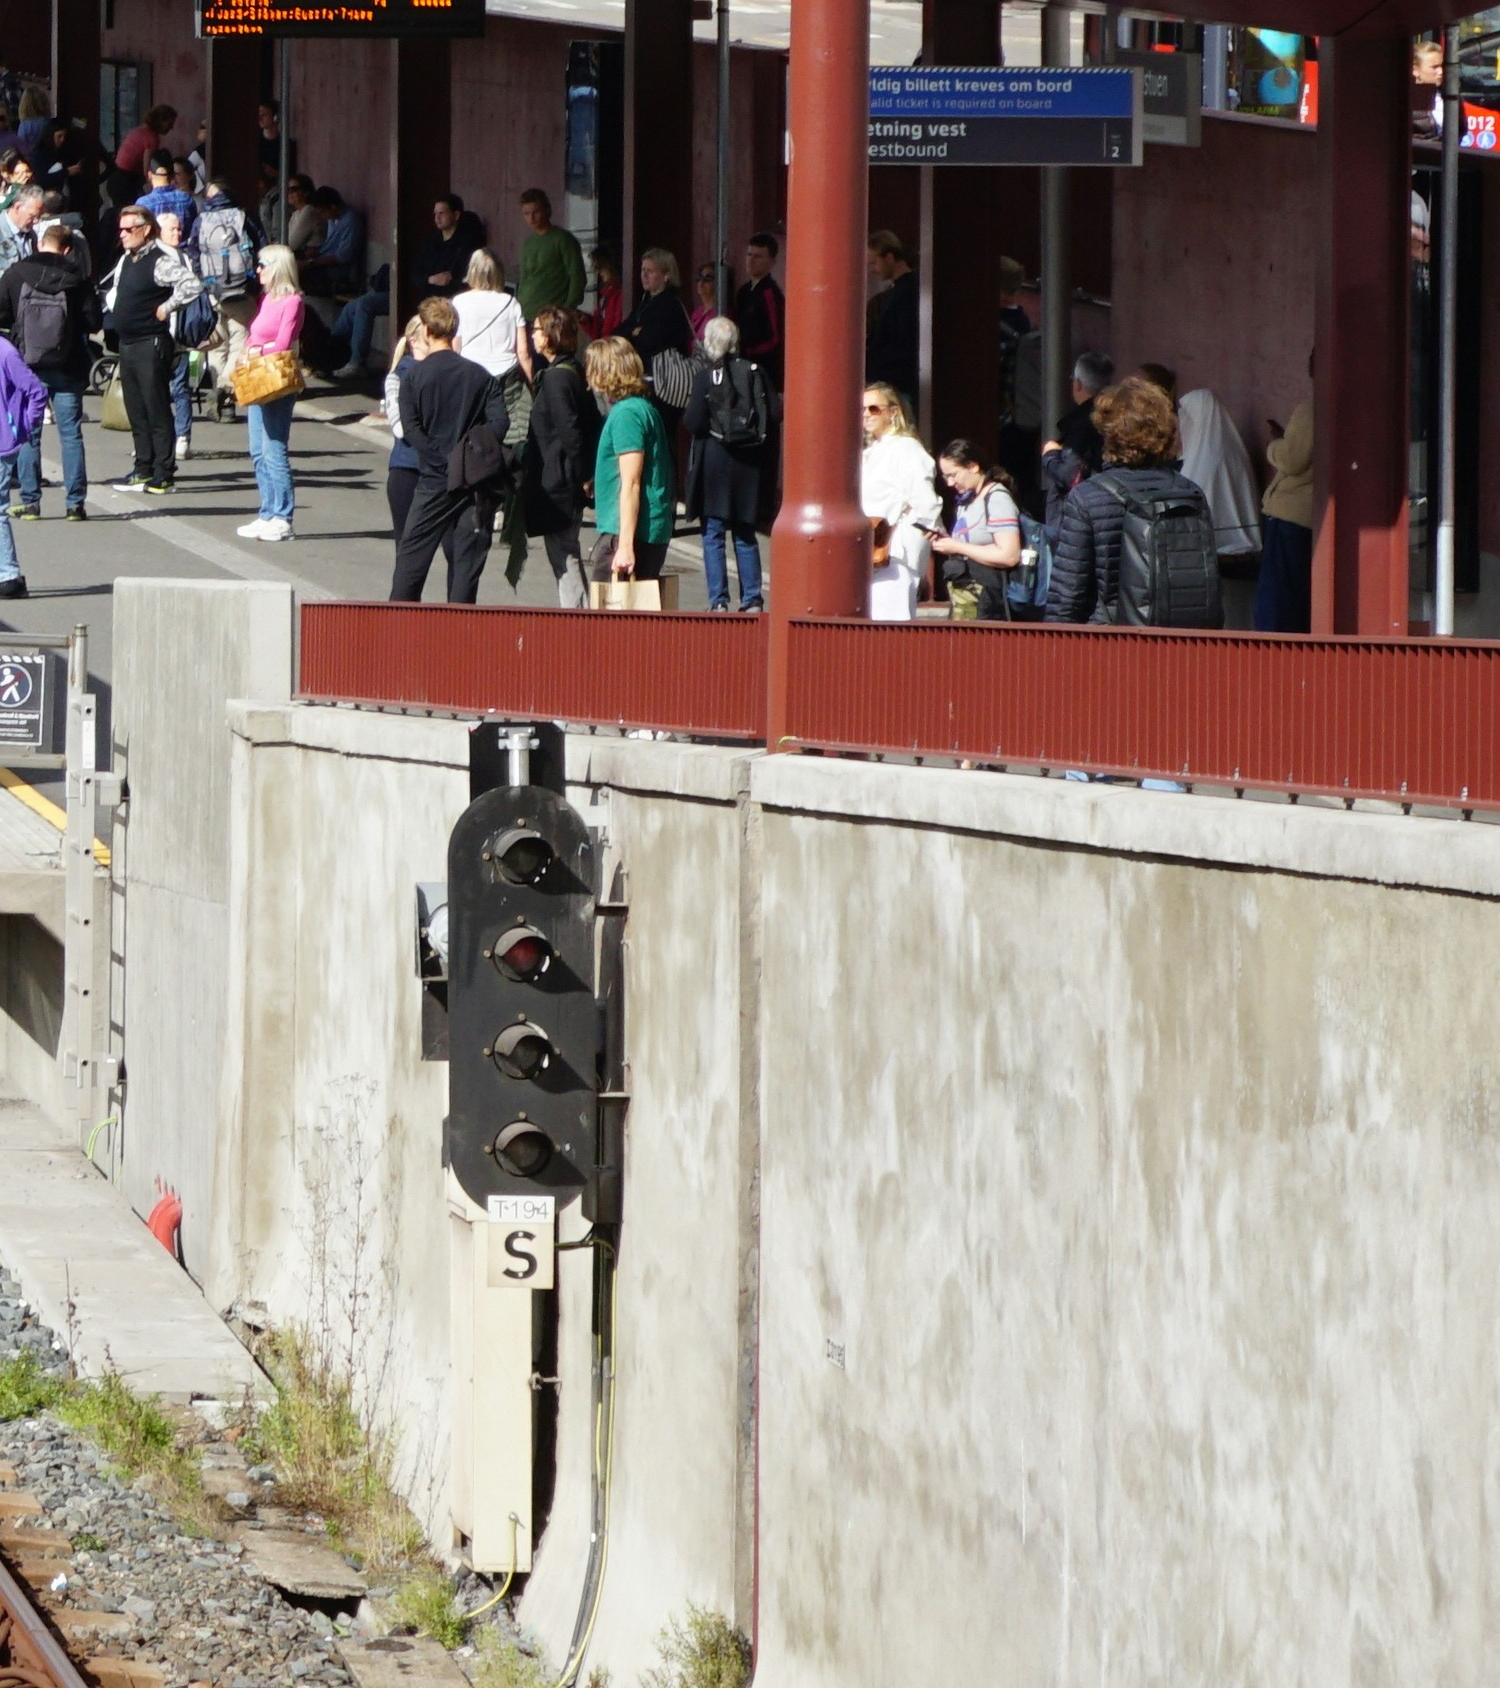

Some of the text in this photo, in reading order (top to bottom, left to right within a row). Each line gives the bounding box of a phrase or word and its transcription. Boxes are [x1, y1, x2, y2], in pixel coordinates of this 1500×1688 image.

[905, 78, 951, 92] billett
[955, 78, 1005, 92] kreves
[1009, 82, 1033, 92] om
[1036, 78, 1072, 92] bord
[896, 97, 929, 108] ticket
[932, 98, 942, 108] is
[946, 98, 996, 112] required
[999, 100, 1015, 109] on
[1017, 98, 1052, 109] board
[928, 123, 967, 137] vest
[1111, 146, 1120, 158] 2
[502, 1230, 538, 1280] S
